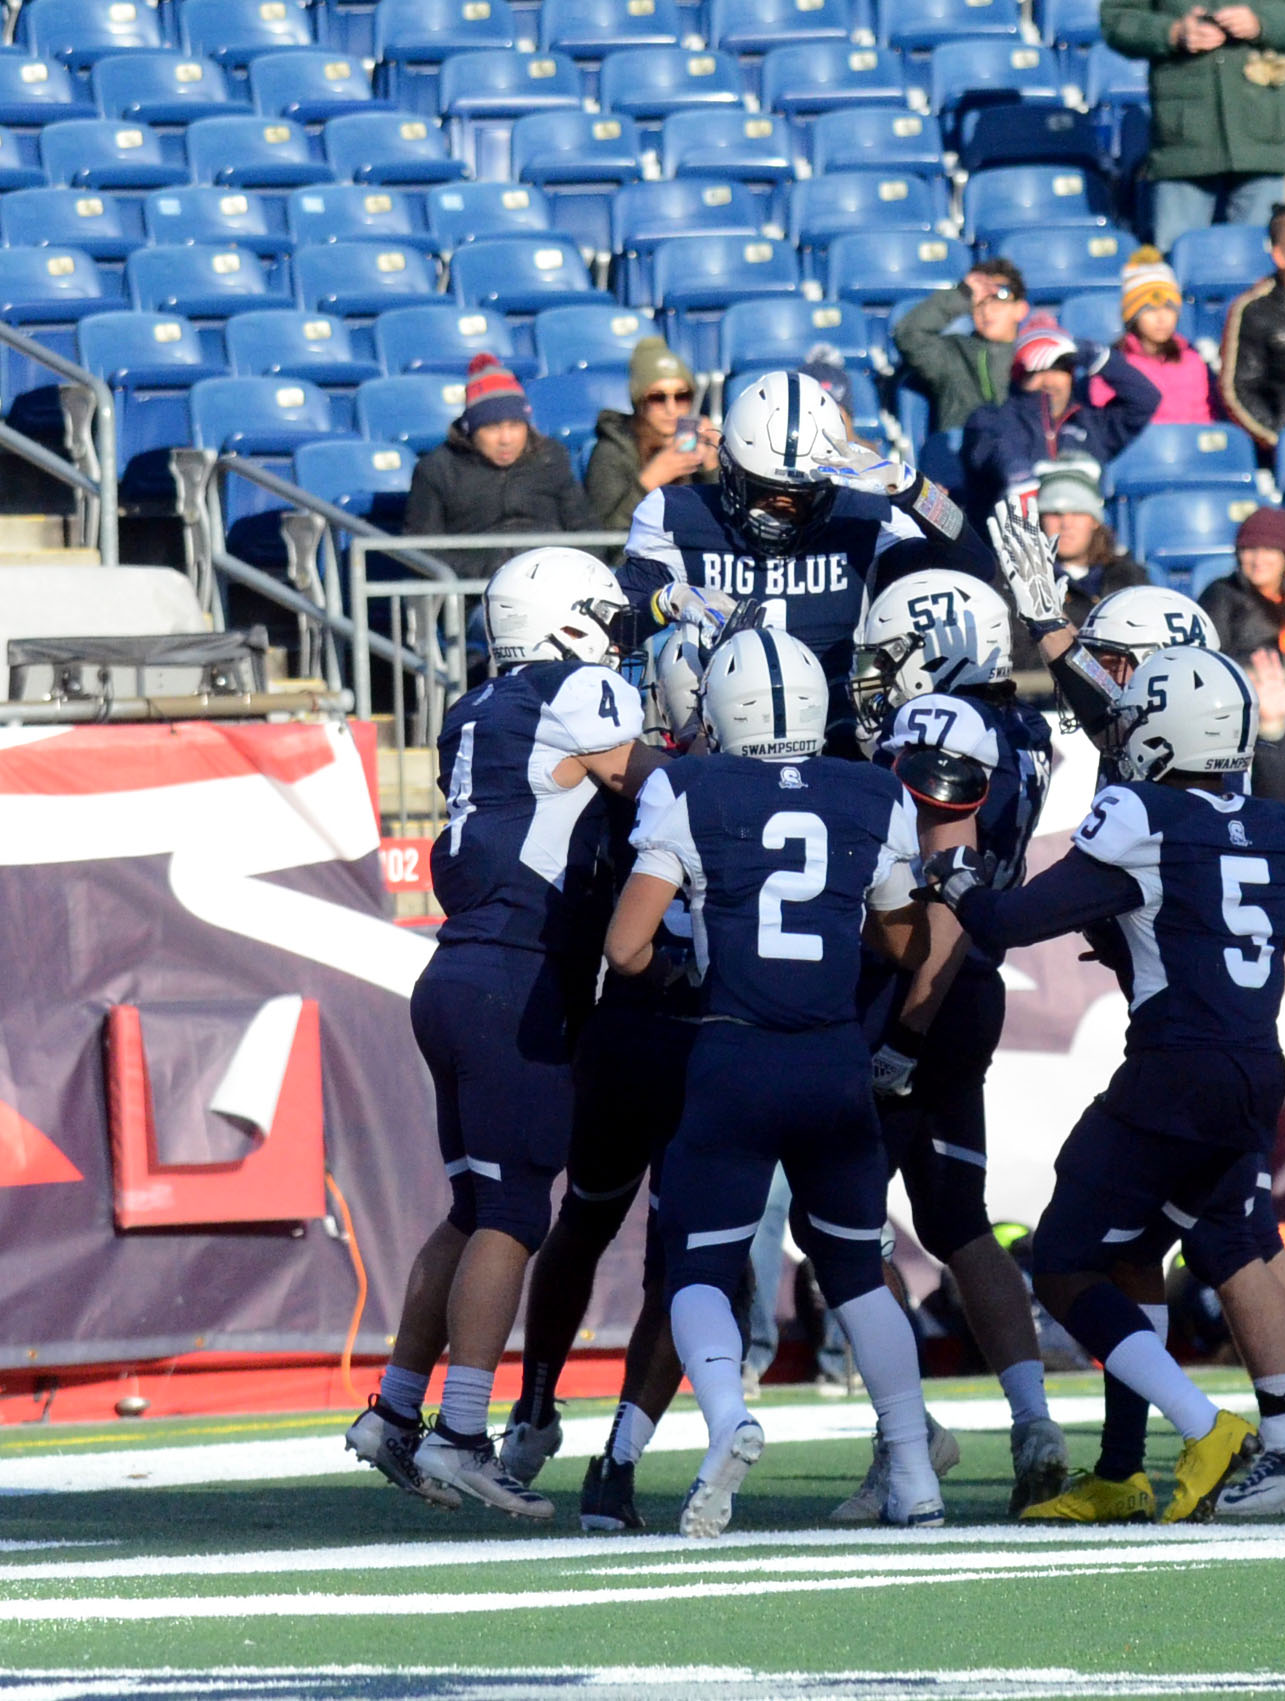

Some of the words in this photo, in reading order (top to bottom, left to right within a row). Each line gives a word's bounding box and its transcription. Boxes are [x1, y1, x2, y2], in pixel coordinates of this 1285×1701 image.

[702, 553, 755, 594] BIG
[765, 552, 848, 595] BLUE
[908, 591, 958, 633] 57
[1164, 612, 1207, 649] 54
[598, 679, 621, 727] 4
[1147, 675, 1169, 713] 5
[741, 740, 817, 757] SWAMPSCOTT
[907, 708, 957, 748] 57
[1079, 797, 1118, 840] 5
[758, 811, 828, 961] 2
[1220, 855, 1275, 989] 5
